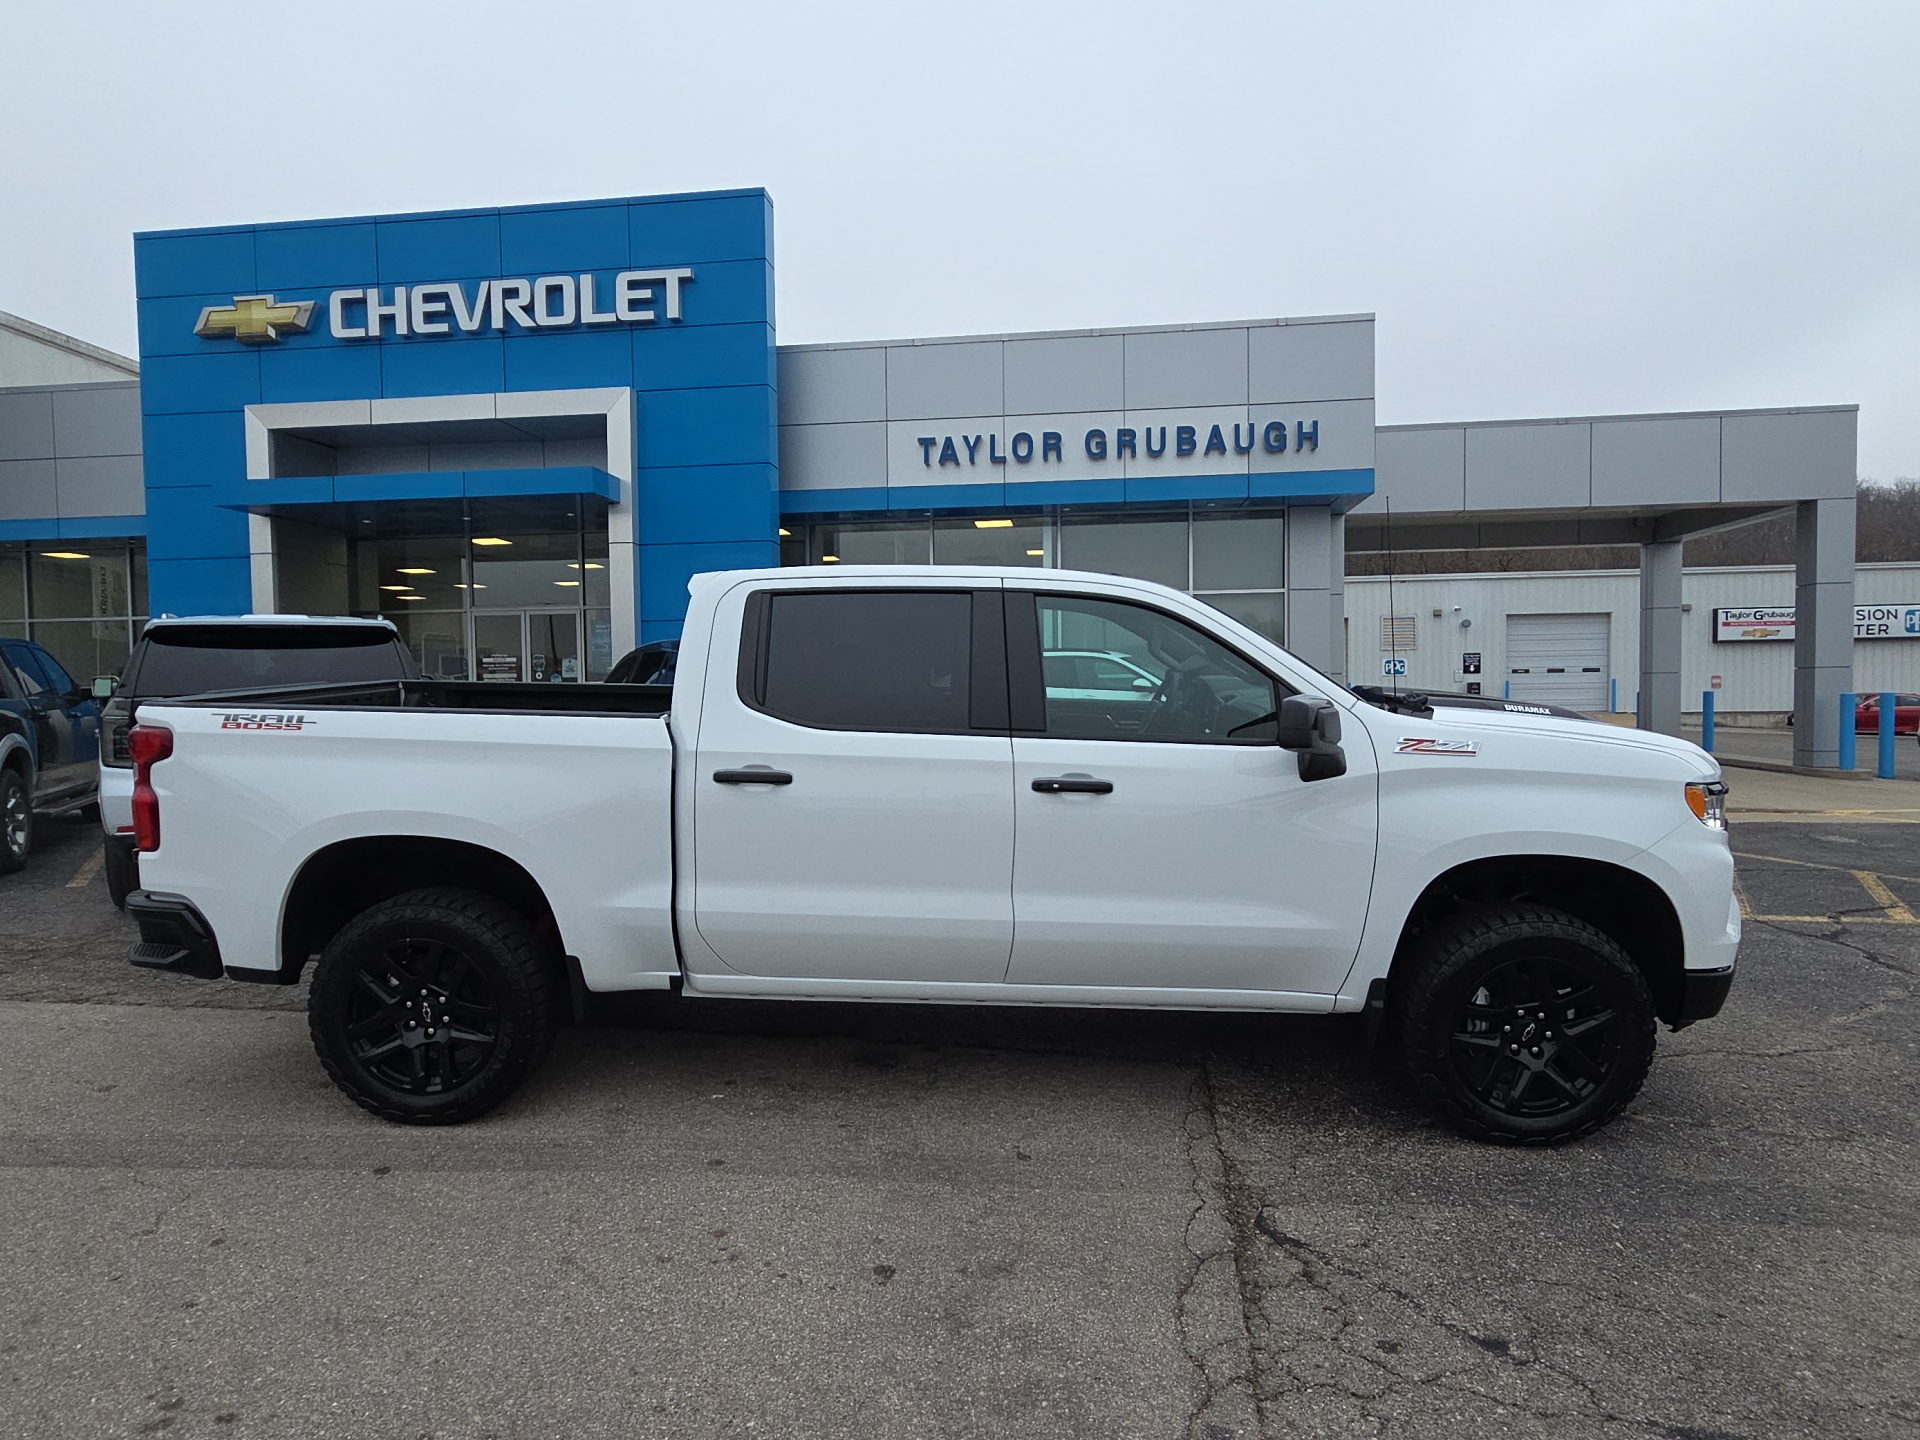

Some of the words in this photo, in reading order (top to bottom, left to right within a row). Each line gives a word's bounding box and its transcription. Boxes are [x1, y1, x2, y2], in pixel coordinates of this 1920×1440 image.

[329, 268, 694, 339] CHEVROLET
[917, 431, 1062, 467] TAYLOR
[1084, 420, 1320, 461] GRUBAUGH
[1722, 610, 1752, 622] Taylor
[1753, 609, 1795, 621] Grubaug
[1385, 661, 1405, 674] PPG
[1504, 704, 1551, 715] DURAMAX
[211, 713, 317, 724] TRAIL
[221, 721, 303, 730] BOSS
[1393, 737, 1483, 757] Z71
